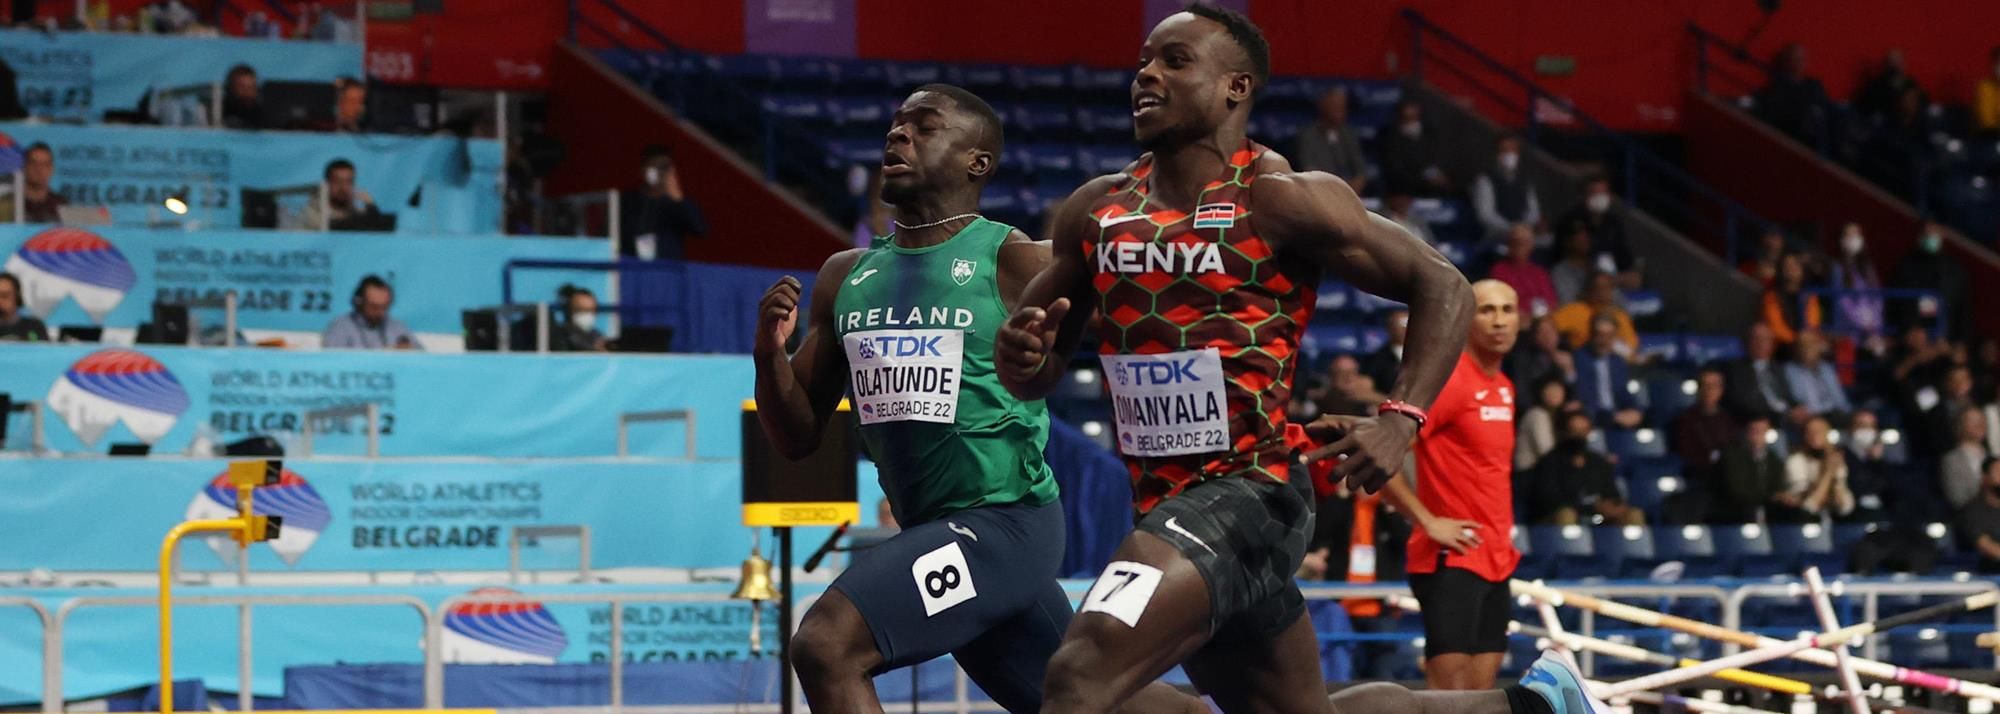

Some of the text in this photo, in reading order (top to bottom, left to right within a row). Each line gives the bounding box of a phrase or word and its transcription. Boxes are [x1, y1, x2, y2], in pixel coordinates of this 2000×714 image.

[1096, 242, 1226, 275] KENYA
[839, 306, 974, 333] IRELAND
[875, 335, 943, 358] TDK
[210, 370, 395, 390] WORLD ATHLETICS
[855, 366, 954, 398] OLATUNDE
[1127, 359, 1202, 386] TDK
[876, 402, 951, 418] BELGRADE 22
[1115, 391, 1220, 427] OMANYALA
[1137, 430, 1224, 451] BELGRADE 22
[350, 482, 542, 502] WORLD ATHLETICS
[780, 507, 838, 520] SEIKO
[352, 525, 502, 549] BELGRADE
[925, 564, 960, 599] 8
[1101, 569, 1141, 602] 7
[587, 606, 664, 625] WRLD
